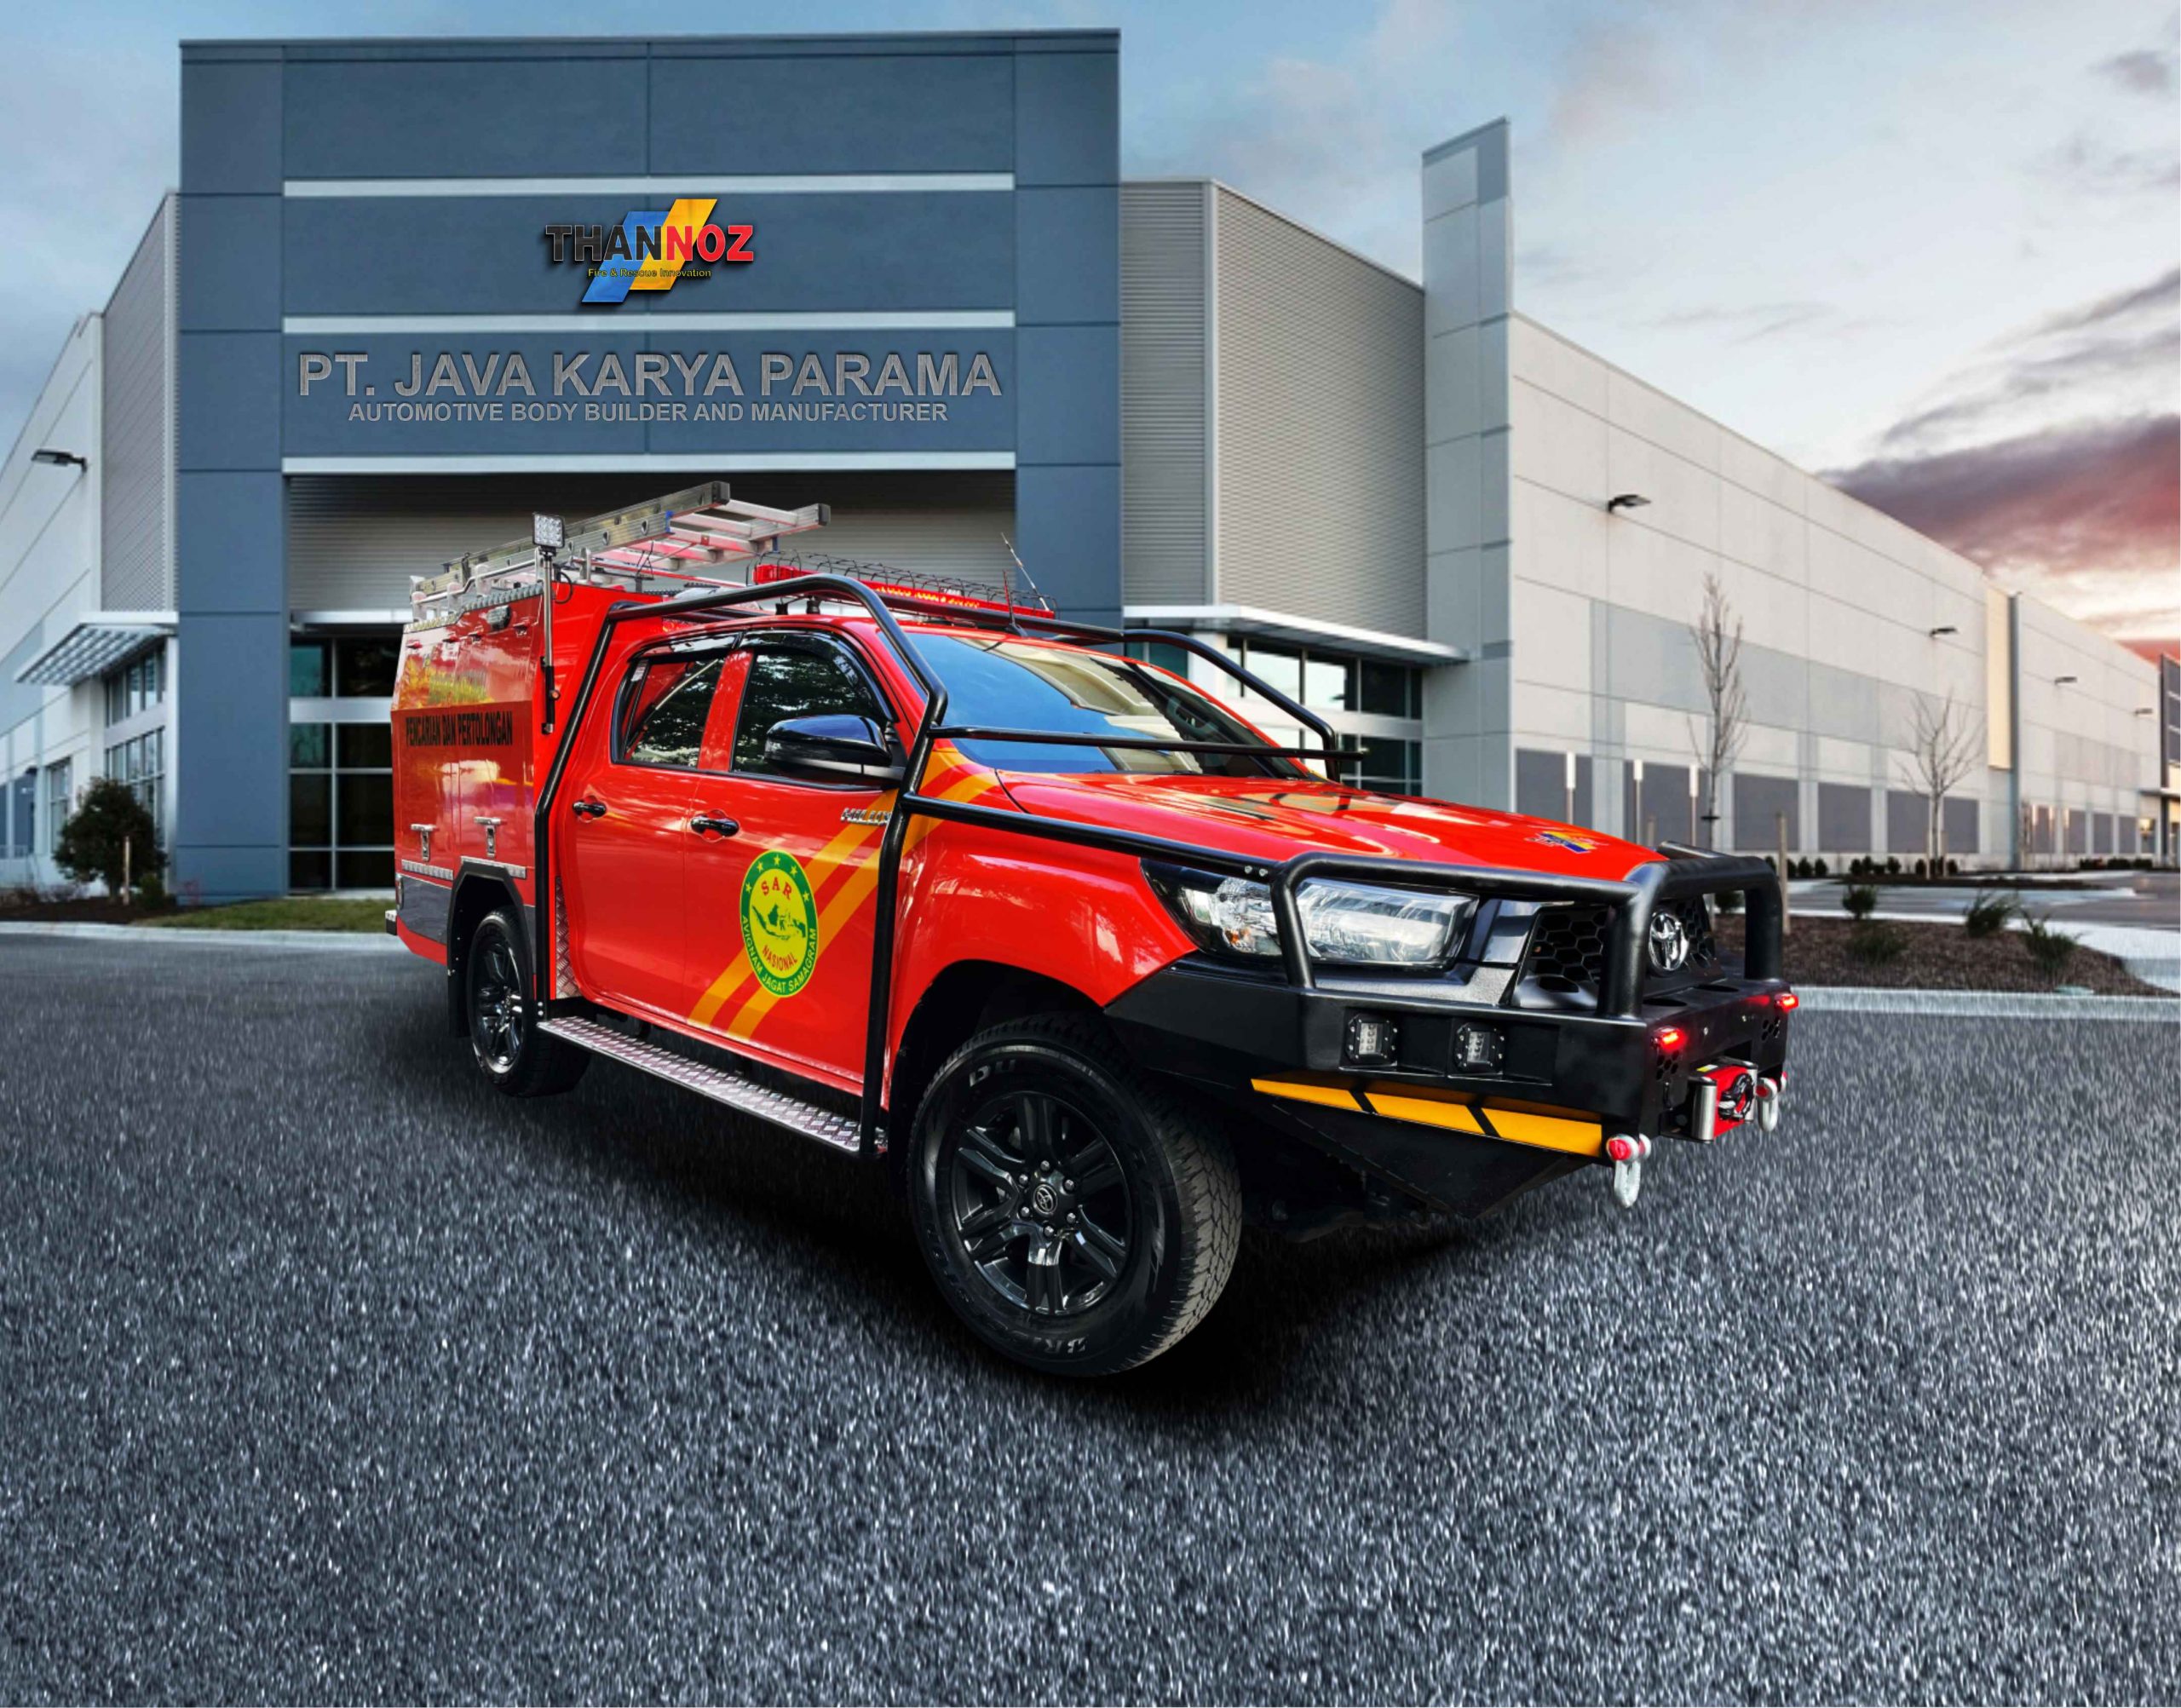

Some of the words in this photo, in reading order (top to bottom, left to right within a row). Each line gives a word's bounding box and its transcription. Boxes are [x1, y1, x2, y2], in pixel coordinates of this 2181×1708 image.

[545, 223, 754, 262] THANNOZ
[588, 268, 607, 277] Fire
[610, 268, 618, 277] &
[620, 268, 658, 277] Rescue
[659, 268, 711, 277] Innovation
[300, 354, 375, 396] PT.
[394, 354, 537, 397] JAVA
[553, 354, 745, 396] KARYA
[761, 354, 1002, 396] PARAMA
[348, 403, 504, 422] AUTOMOTIVE
[510, 403, 578, 422] BODY
[584, 403, 688, 422] BUILDER
[693, 403, 744, 422] AND
[751, 403, 948, 422] MANUFACTURER
[406, 716, 440, 745] PENCARIAN
[442, 714, 456, 745] DAN
[457, 710, 513, 745] PERTOLONGAN
[760, 876, 792, 901] SAR
[741, 914, 763, 975] AVIGNAM
[762, 973, 787, 993] JAGAT
[788, 928, 817, 992] SAMAGRAM
[762, 944, 798, 972] NASIONAL
